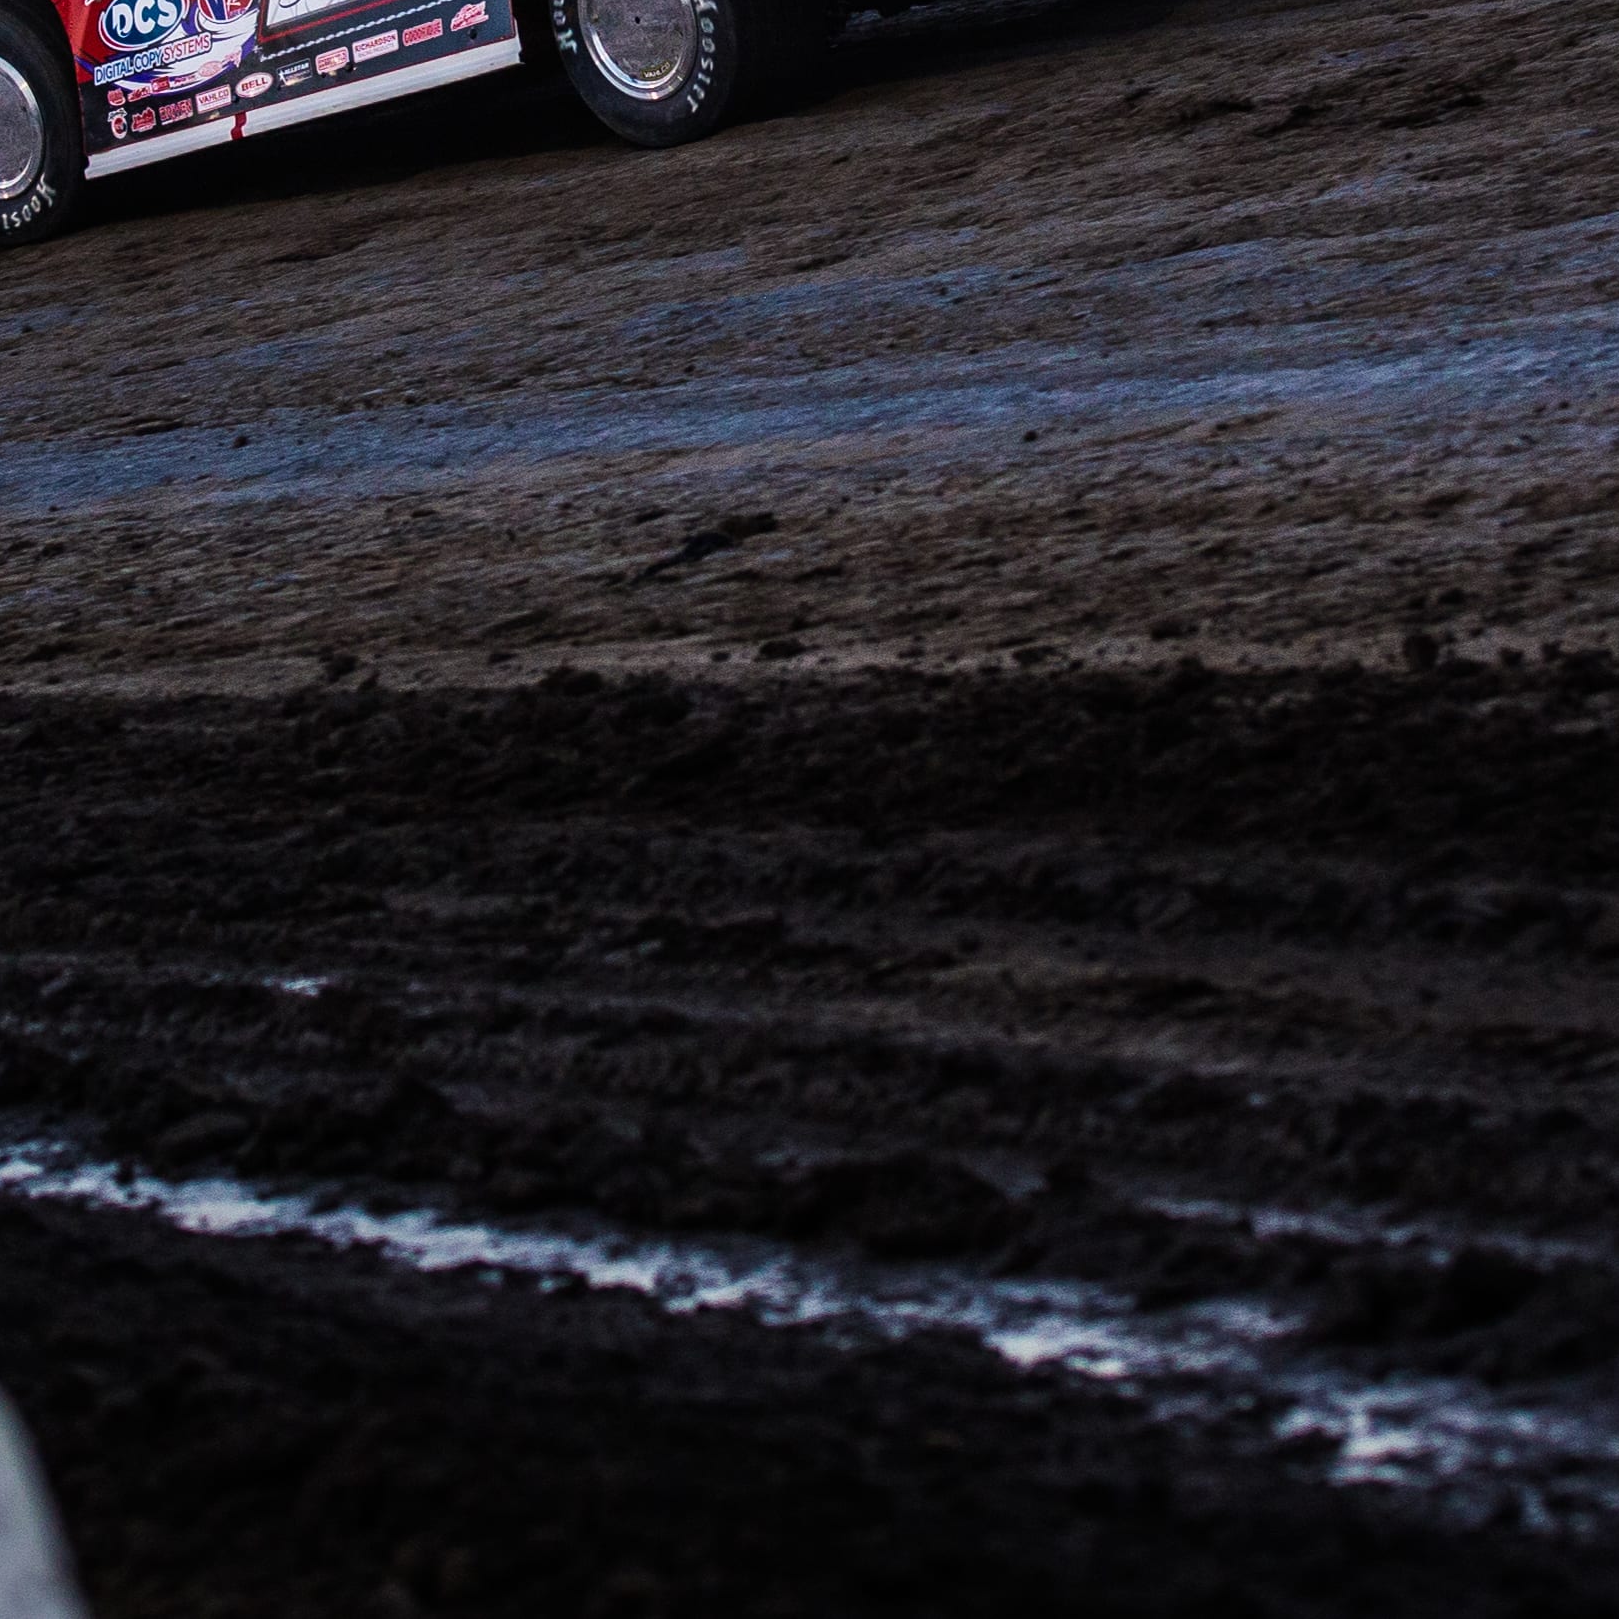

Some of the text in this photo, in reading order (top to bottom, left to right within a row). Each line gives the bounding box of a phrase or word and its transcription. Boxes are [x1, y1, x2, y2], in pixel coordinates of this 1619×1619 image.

[95, 35, 212, 84] DIGITAL COPY SYSTEMS
[241, 77, 268, 92] BELL
[198, 90, 230, 105] VAHLCO
